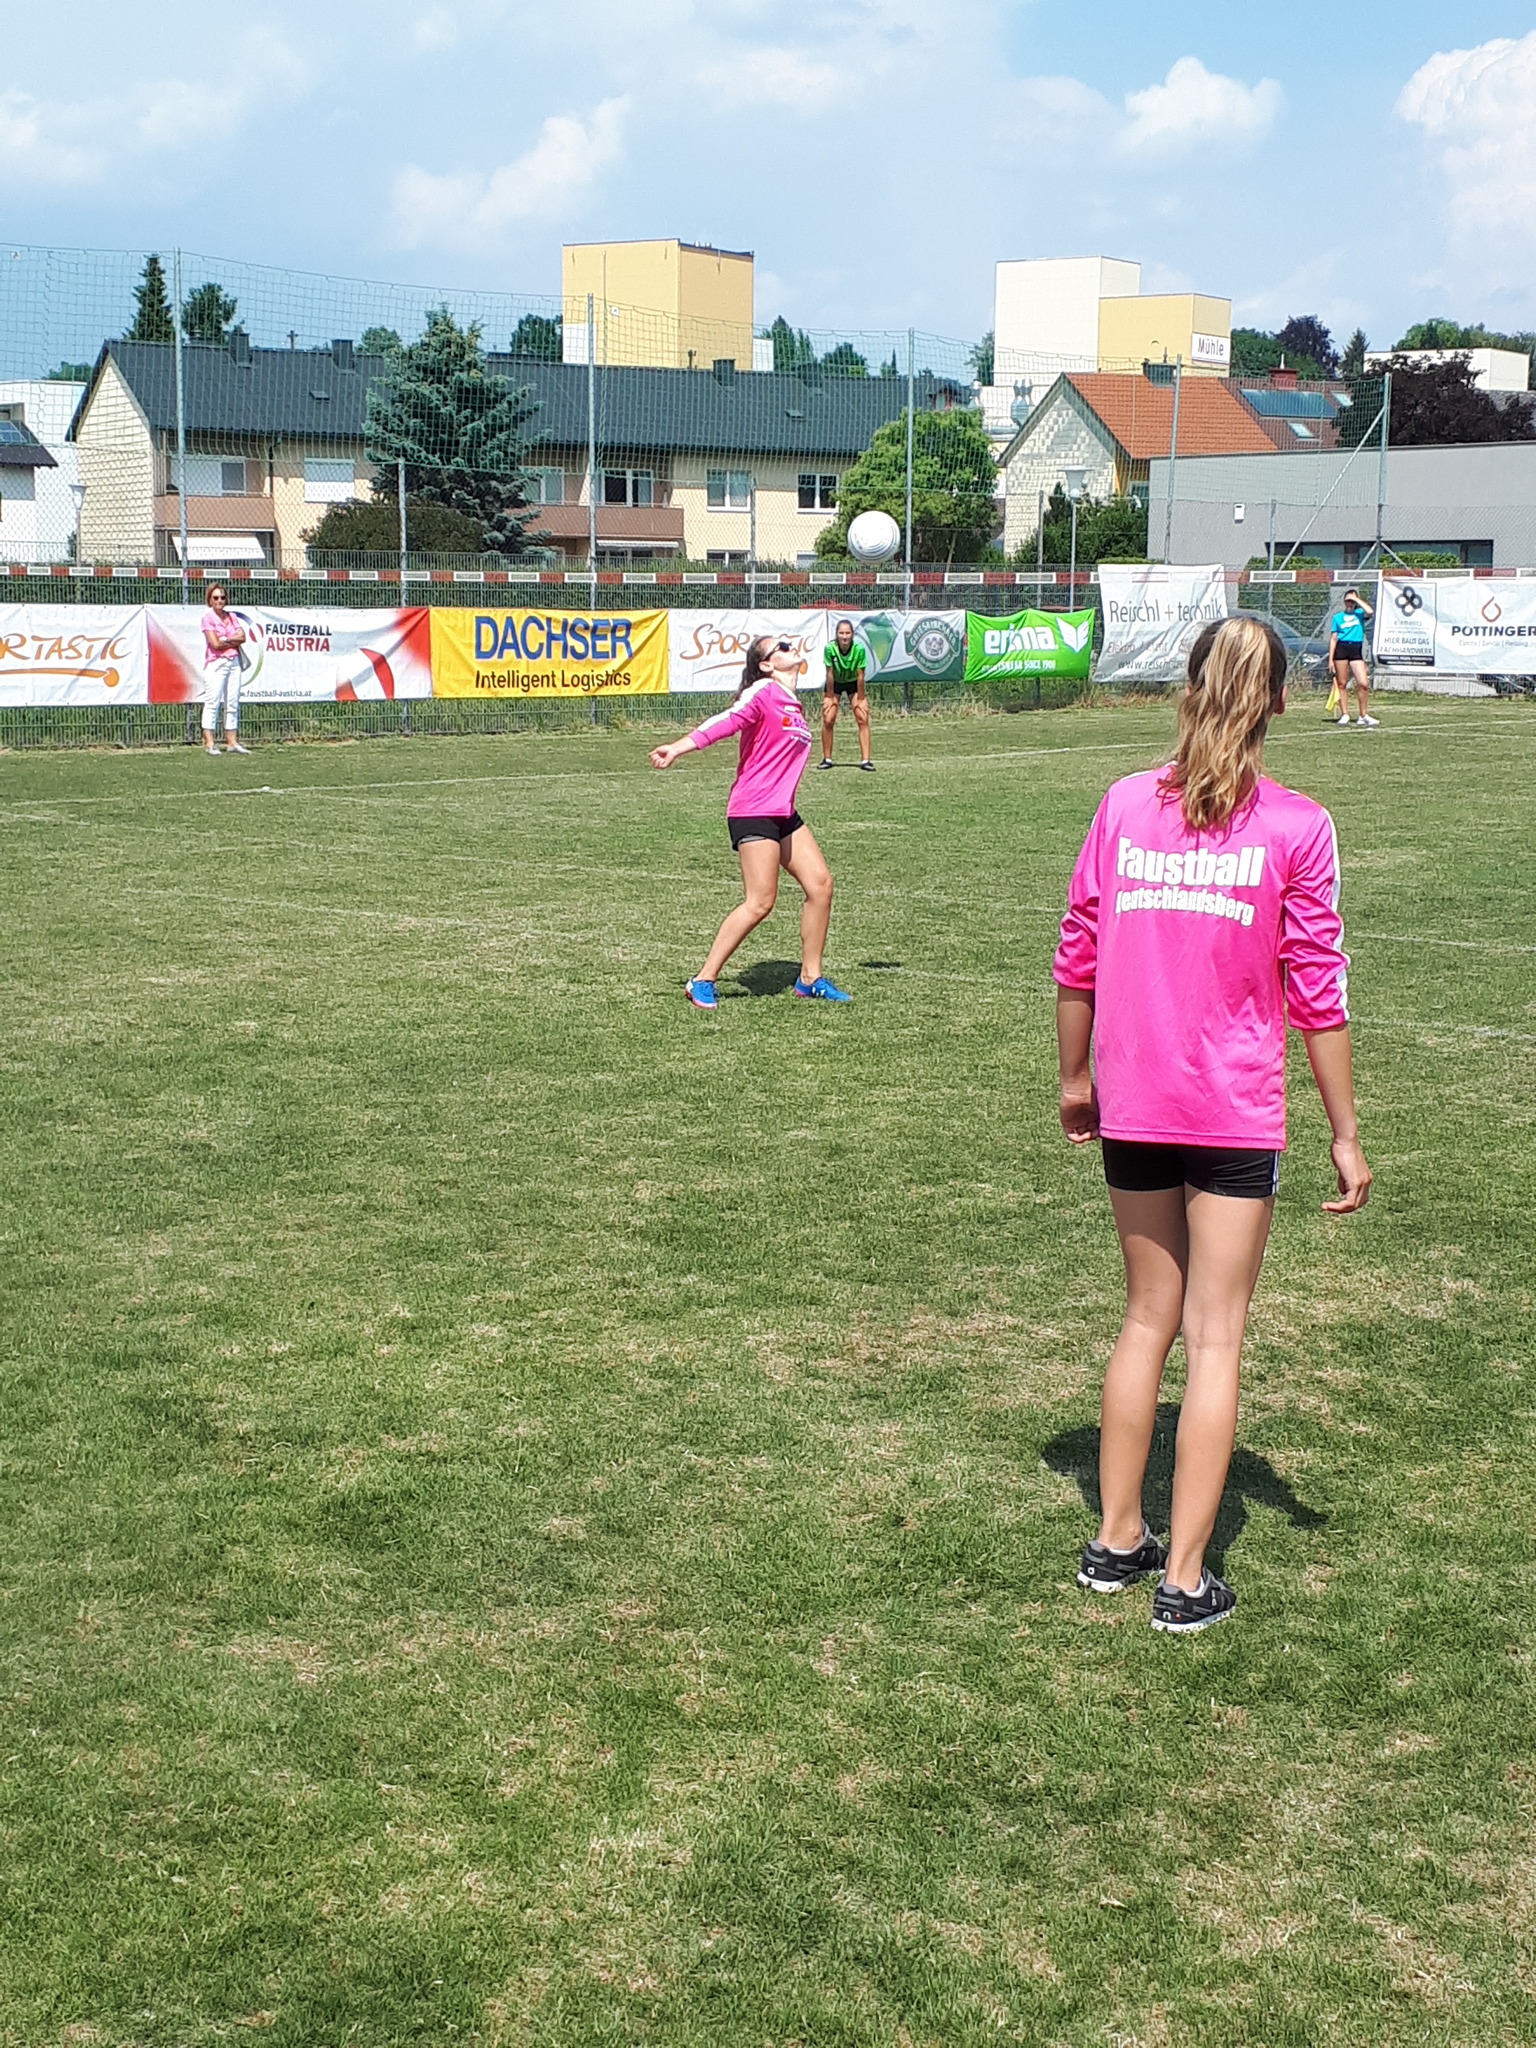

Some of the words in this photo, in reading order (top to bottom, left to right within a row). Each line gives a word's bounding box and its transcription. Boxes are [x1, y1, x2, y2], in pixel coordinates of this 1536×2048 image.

[1197, 337, 1225, 356] Mühle
[1109, 599, 1161, 623] Reischl
[1177, 597, 1224, 621] technik
[265, 623, 332, 636] FAUSTBALL
[474, 615, 633, 660] DACHSER
[0, 632, 132, 660] RTASTIC
[265, 637, 330, 652] AUSTRIA
[475, 670, 557, 692] Intelligent
[561, 669, 632, 692] Logistics
[1117, 836, 1266, 887] Faustball
